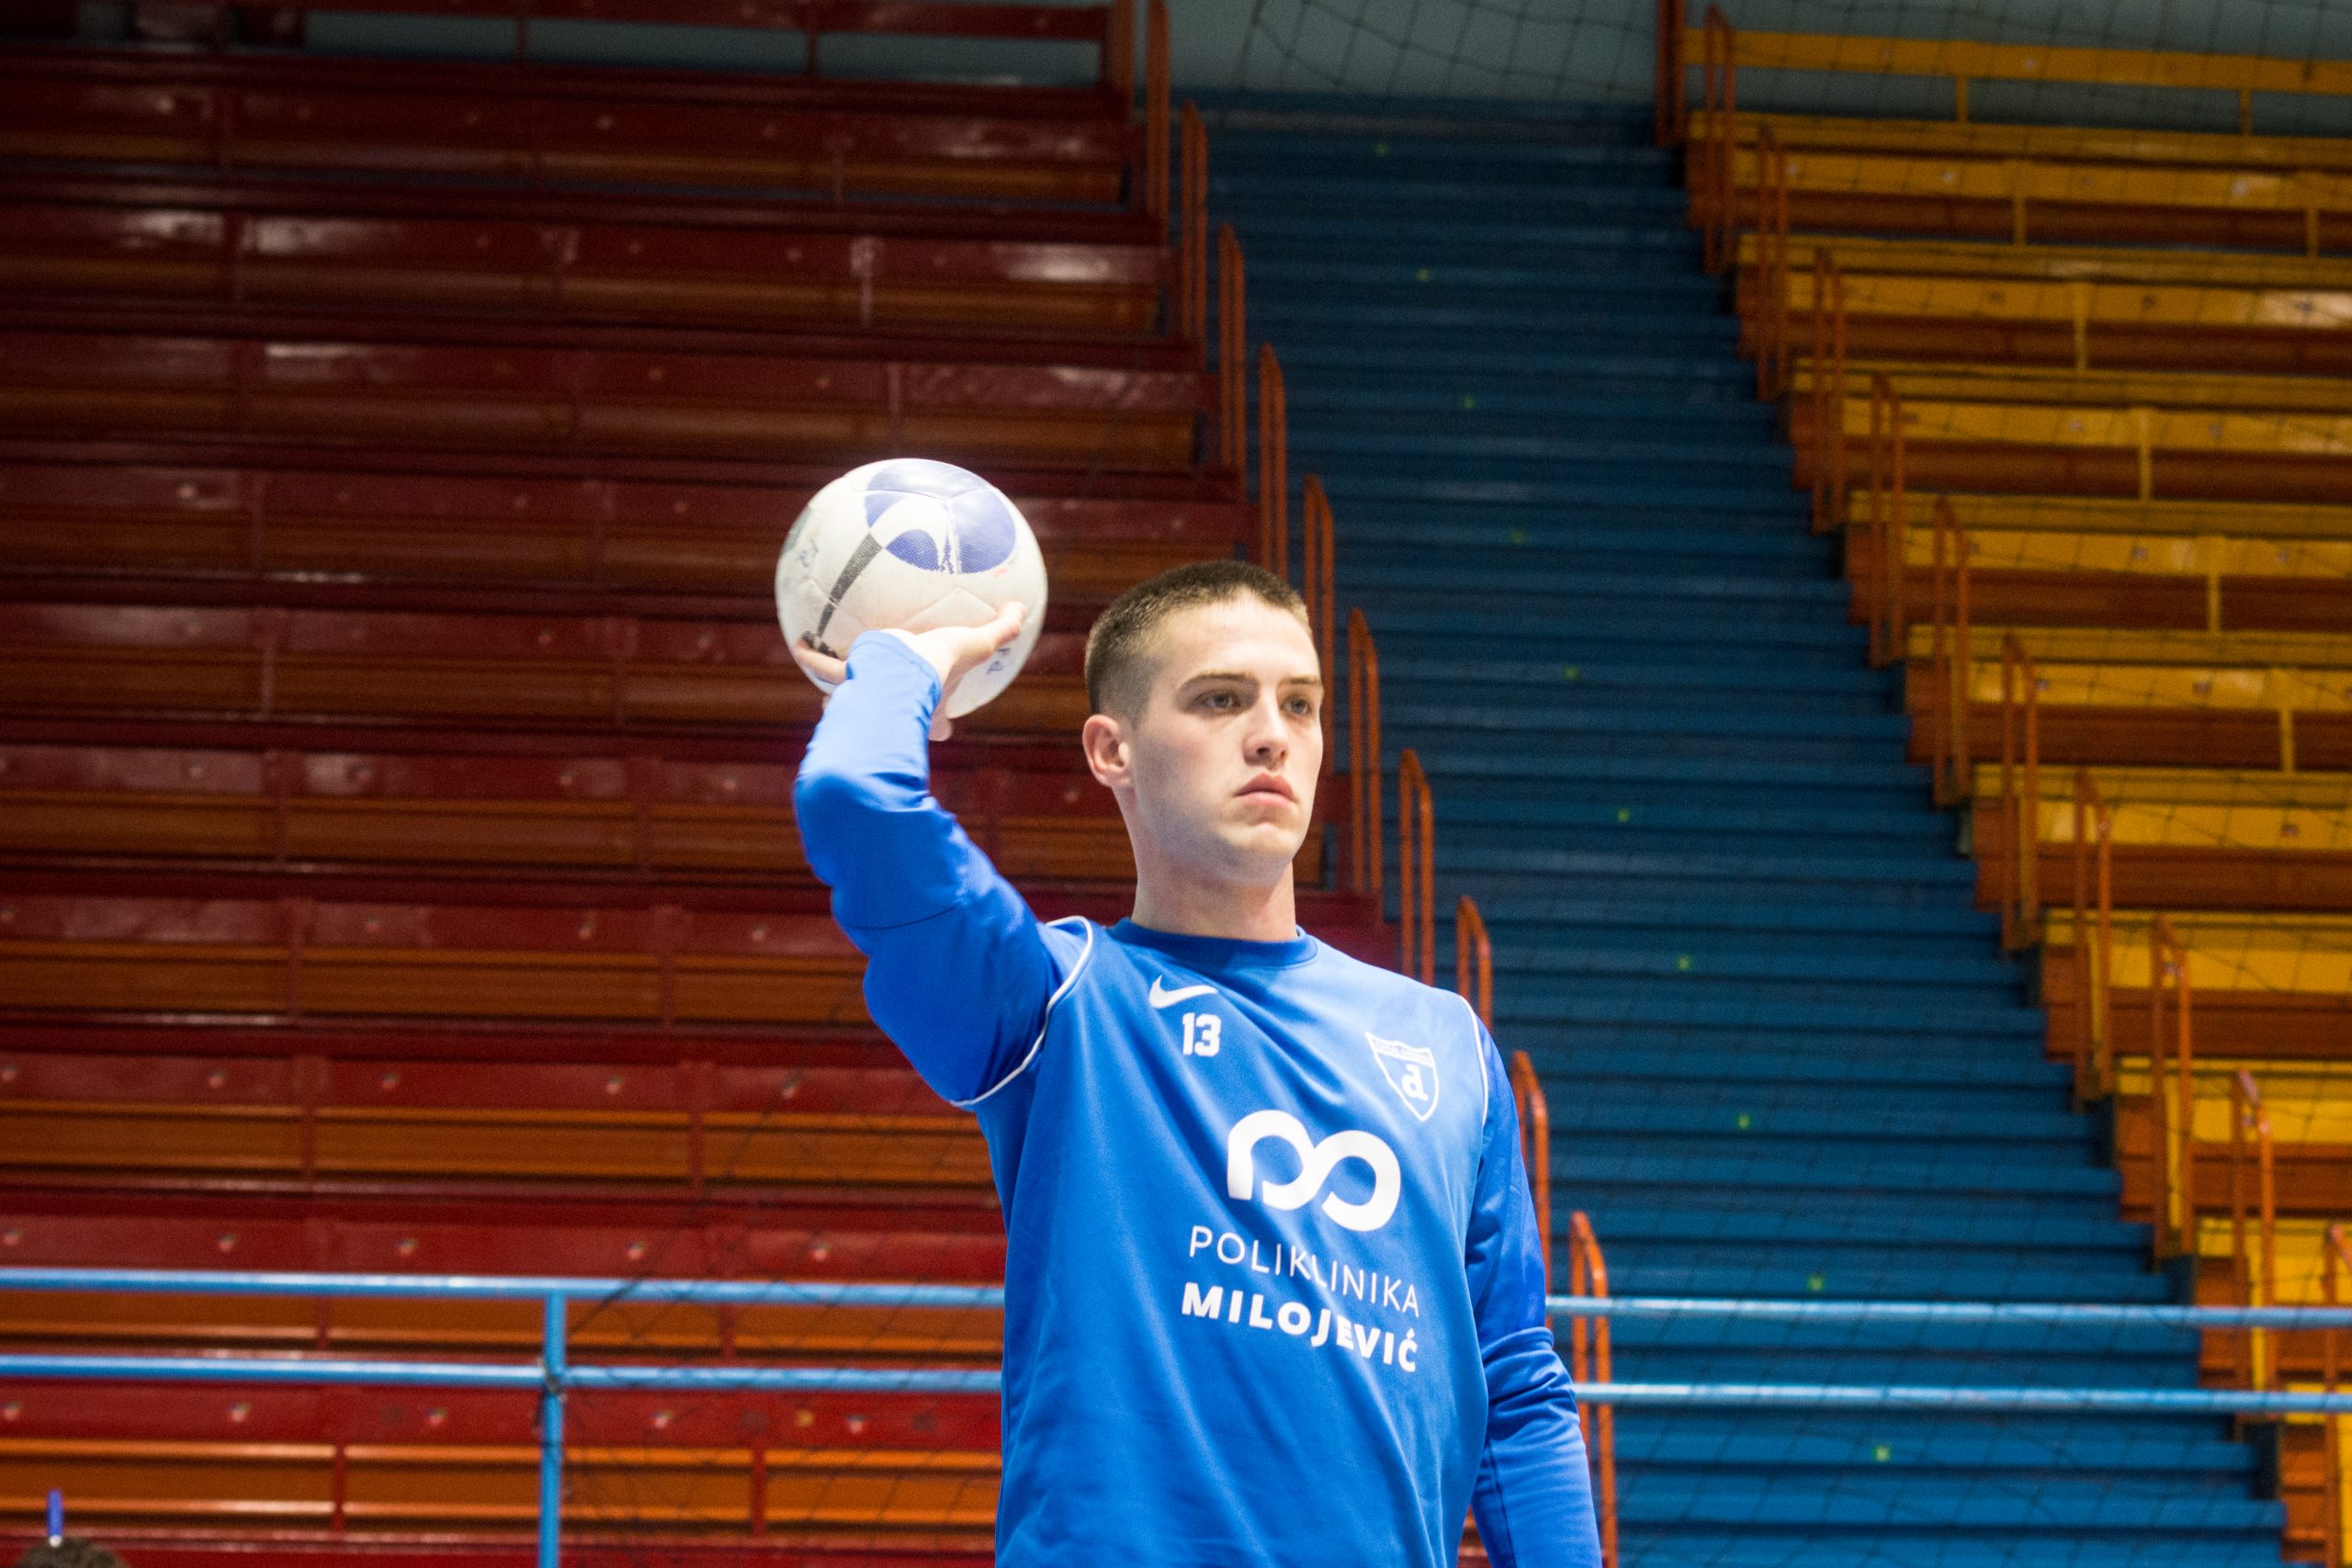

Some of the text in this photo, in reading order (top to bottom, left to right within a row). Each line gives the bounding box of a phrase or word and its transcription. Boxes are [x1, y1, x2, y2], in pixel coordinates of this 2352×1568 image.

[1182, 1012, 1222, 1057] 13
[1189, 1225, 1419, 1319] POLIKLINIKA
[1182, 1281, 1419, 1372] MILOJEVIĆ
